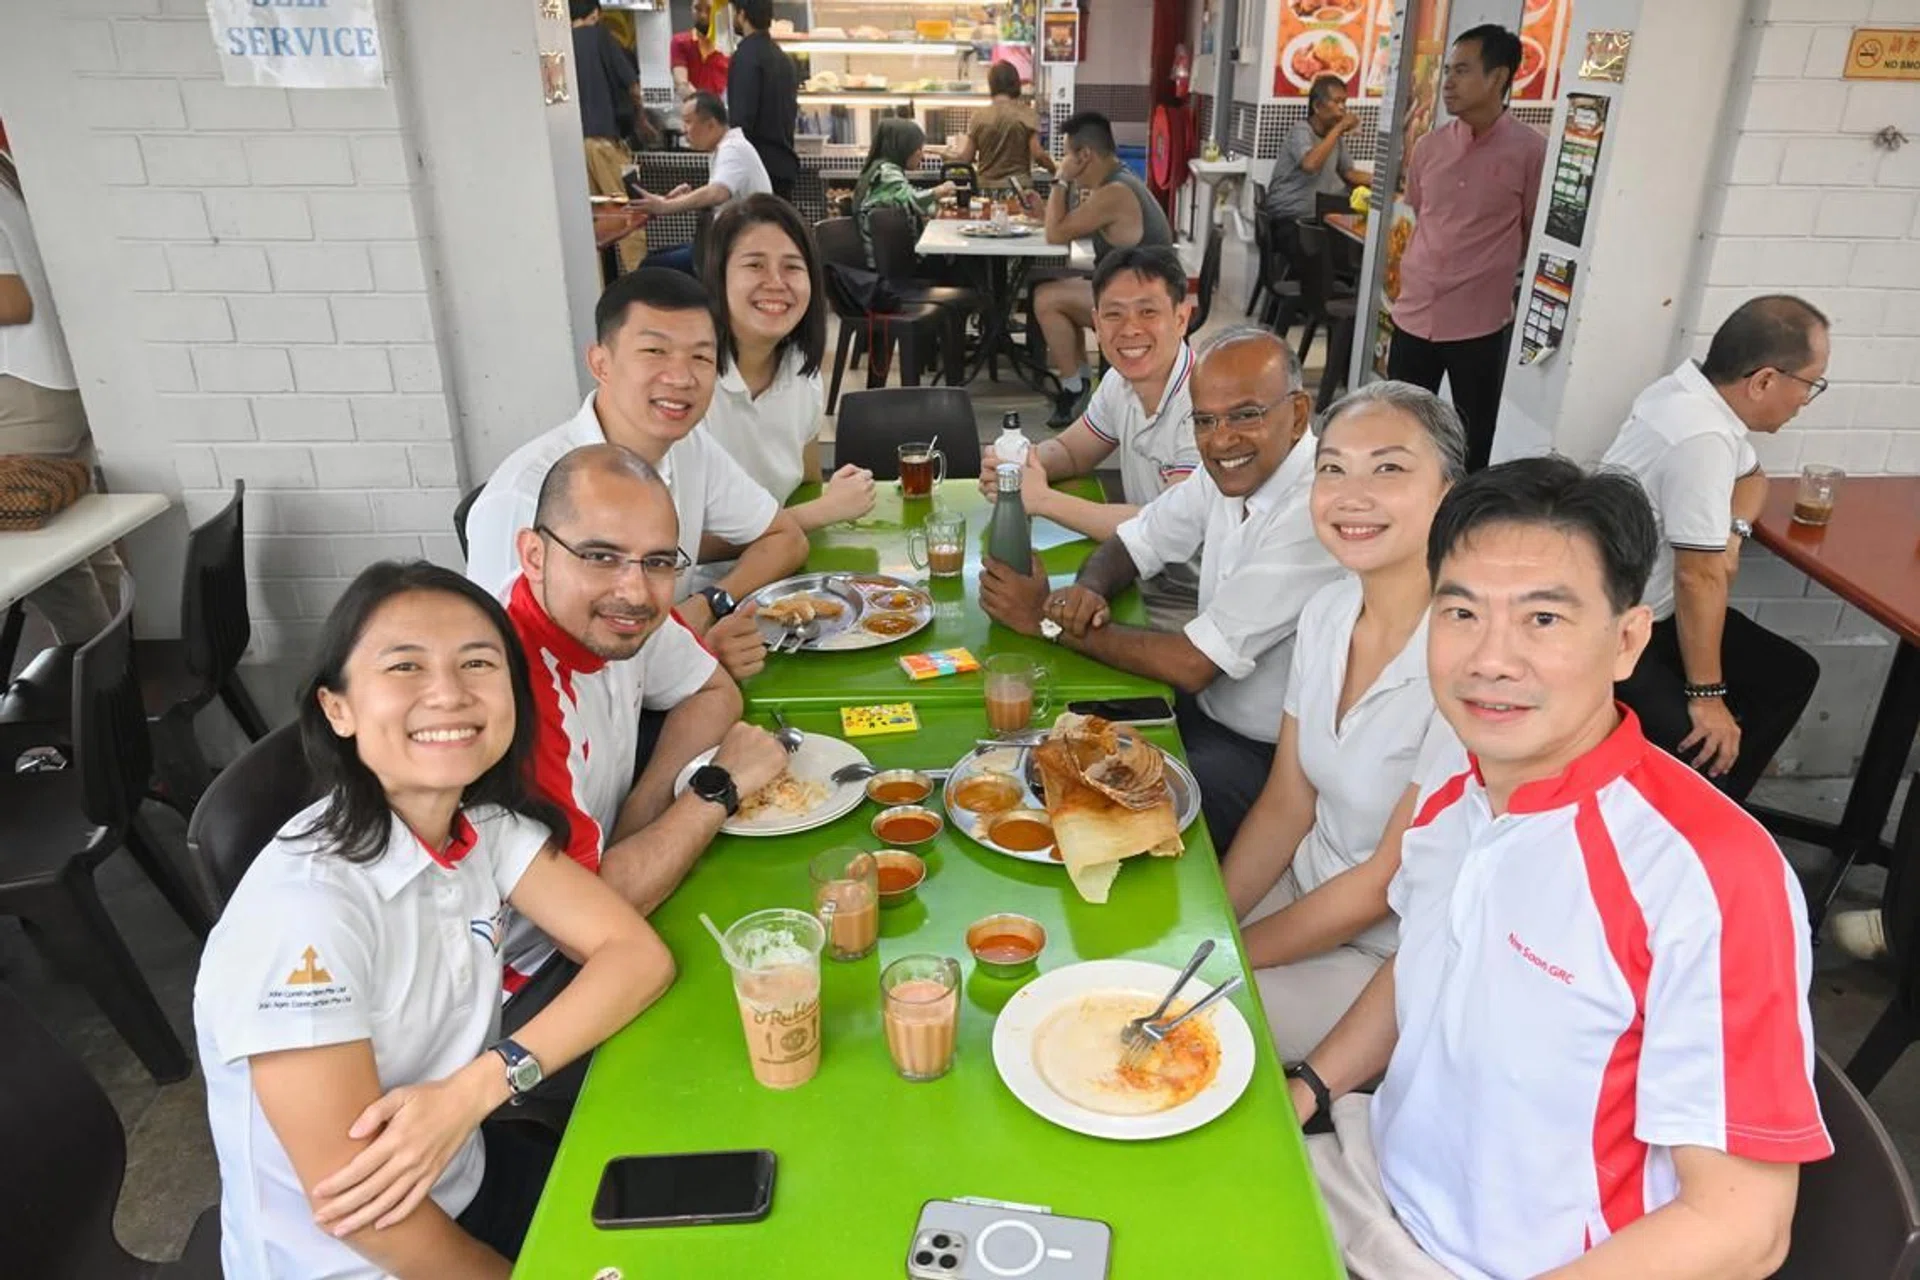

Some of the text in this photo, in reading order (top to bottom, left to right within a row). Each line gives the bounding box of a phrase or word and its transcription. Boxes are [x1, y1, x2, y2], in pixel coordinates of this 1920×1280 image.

[226, 27, 377, 56] SERVICE
[1883, 60, 1898, 68] NO
[1523, 946, 1547, 971] Soon
[1548, 965, 1575, 985] GRC
